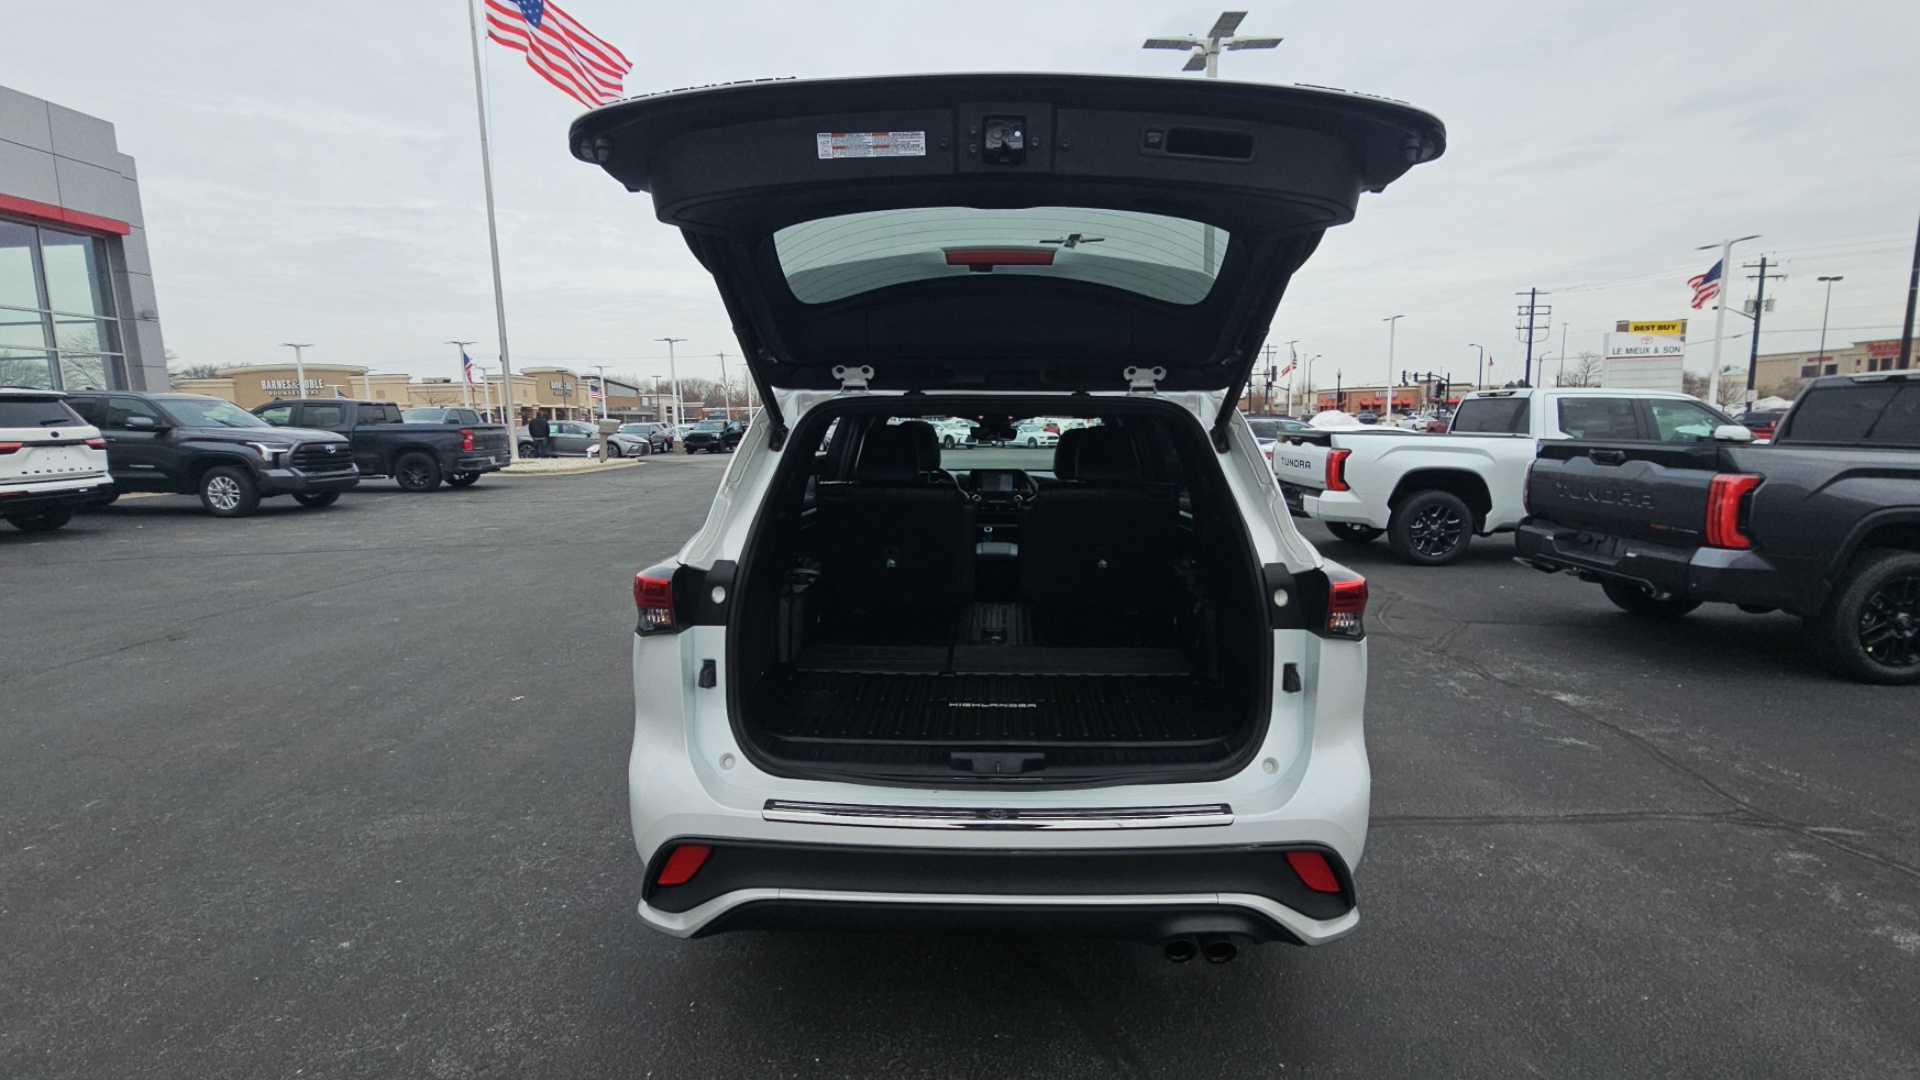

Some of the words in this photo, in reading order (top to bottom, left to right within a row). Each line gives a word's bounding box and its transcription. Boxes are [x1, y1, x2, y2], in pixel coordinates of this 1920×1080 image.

[1612, 347, 1622, 355] LE
[261, 380, 292, 390] BARNES
[303, 379, 324, 389] OBLE
[1281, 457, 1311, 470] TUNDRA
[1555, 482, 1655, 510] TUNDRA
